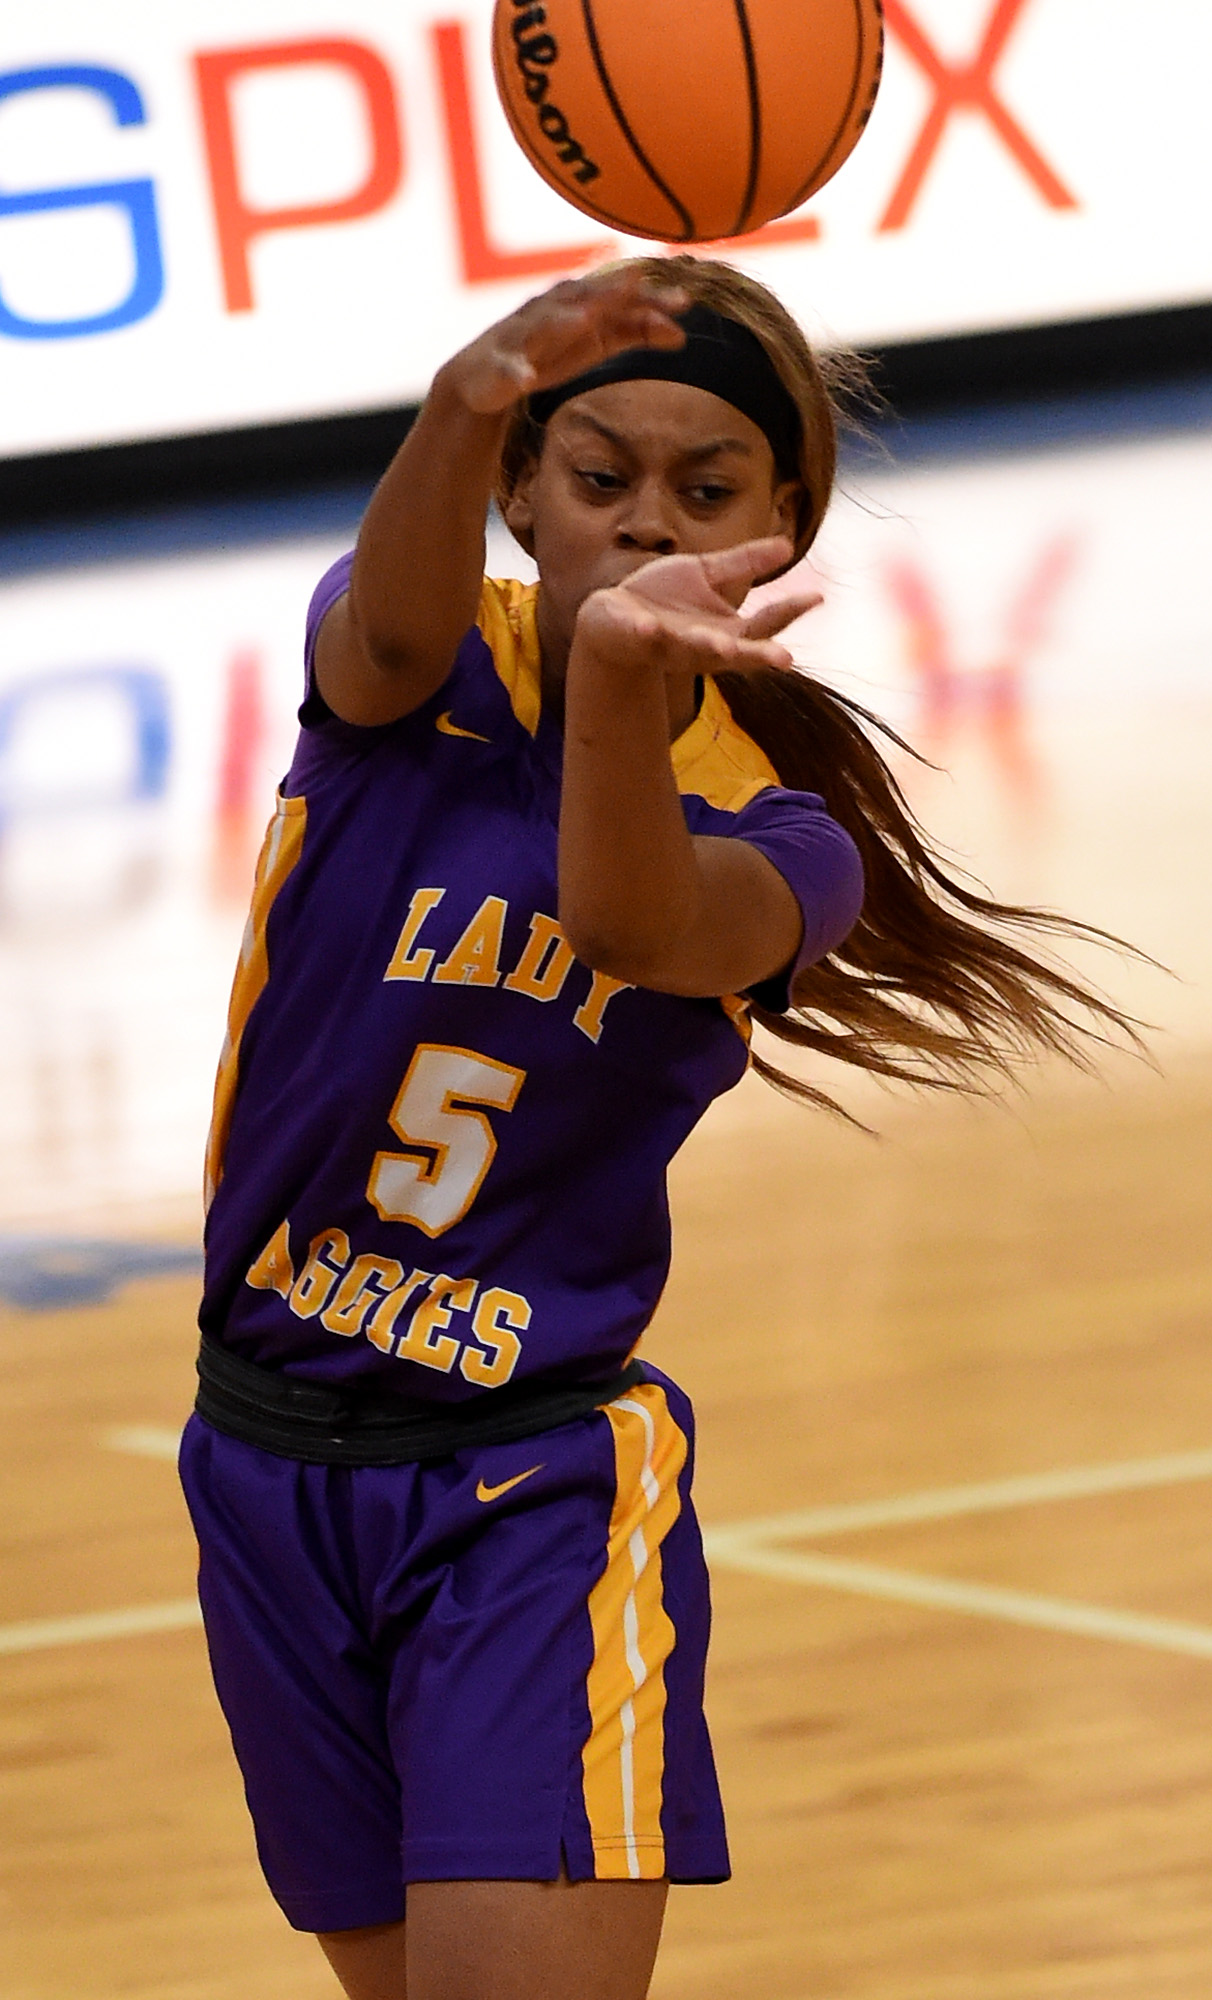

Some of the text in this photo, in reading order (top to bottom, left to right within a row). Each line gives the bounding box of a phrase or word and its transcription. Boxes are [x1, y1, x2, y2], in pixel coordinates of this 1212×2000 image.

[511, 0, 601, 185] ilson
[383, 887, 637, 1045] LADY
[366, 1043, 527, 1240] 5
[245, 1218, 533, 1389] AGGIES
